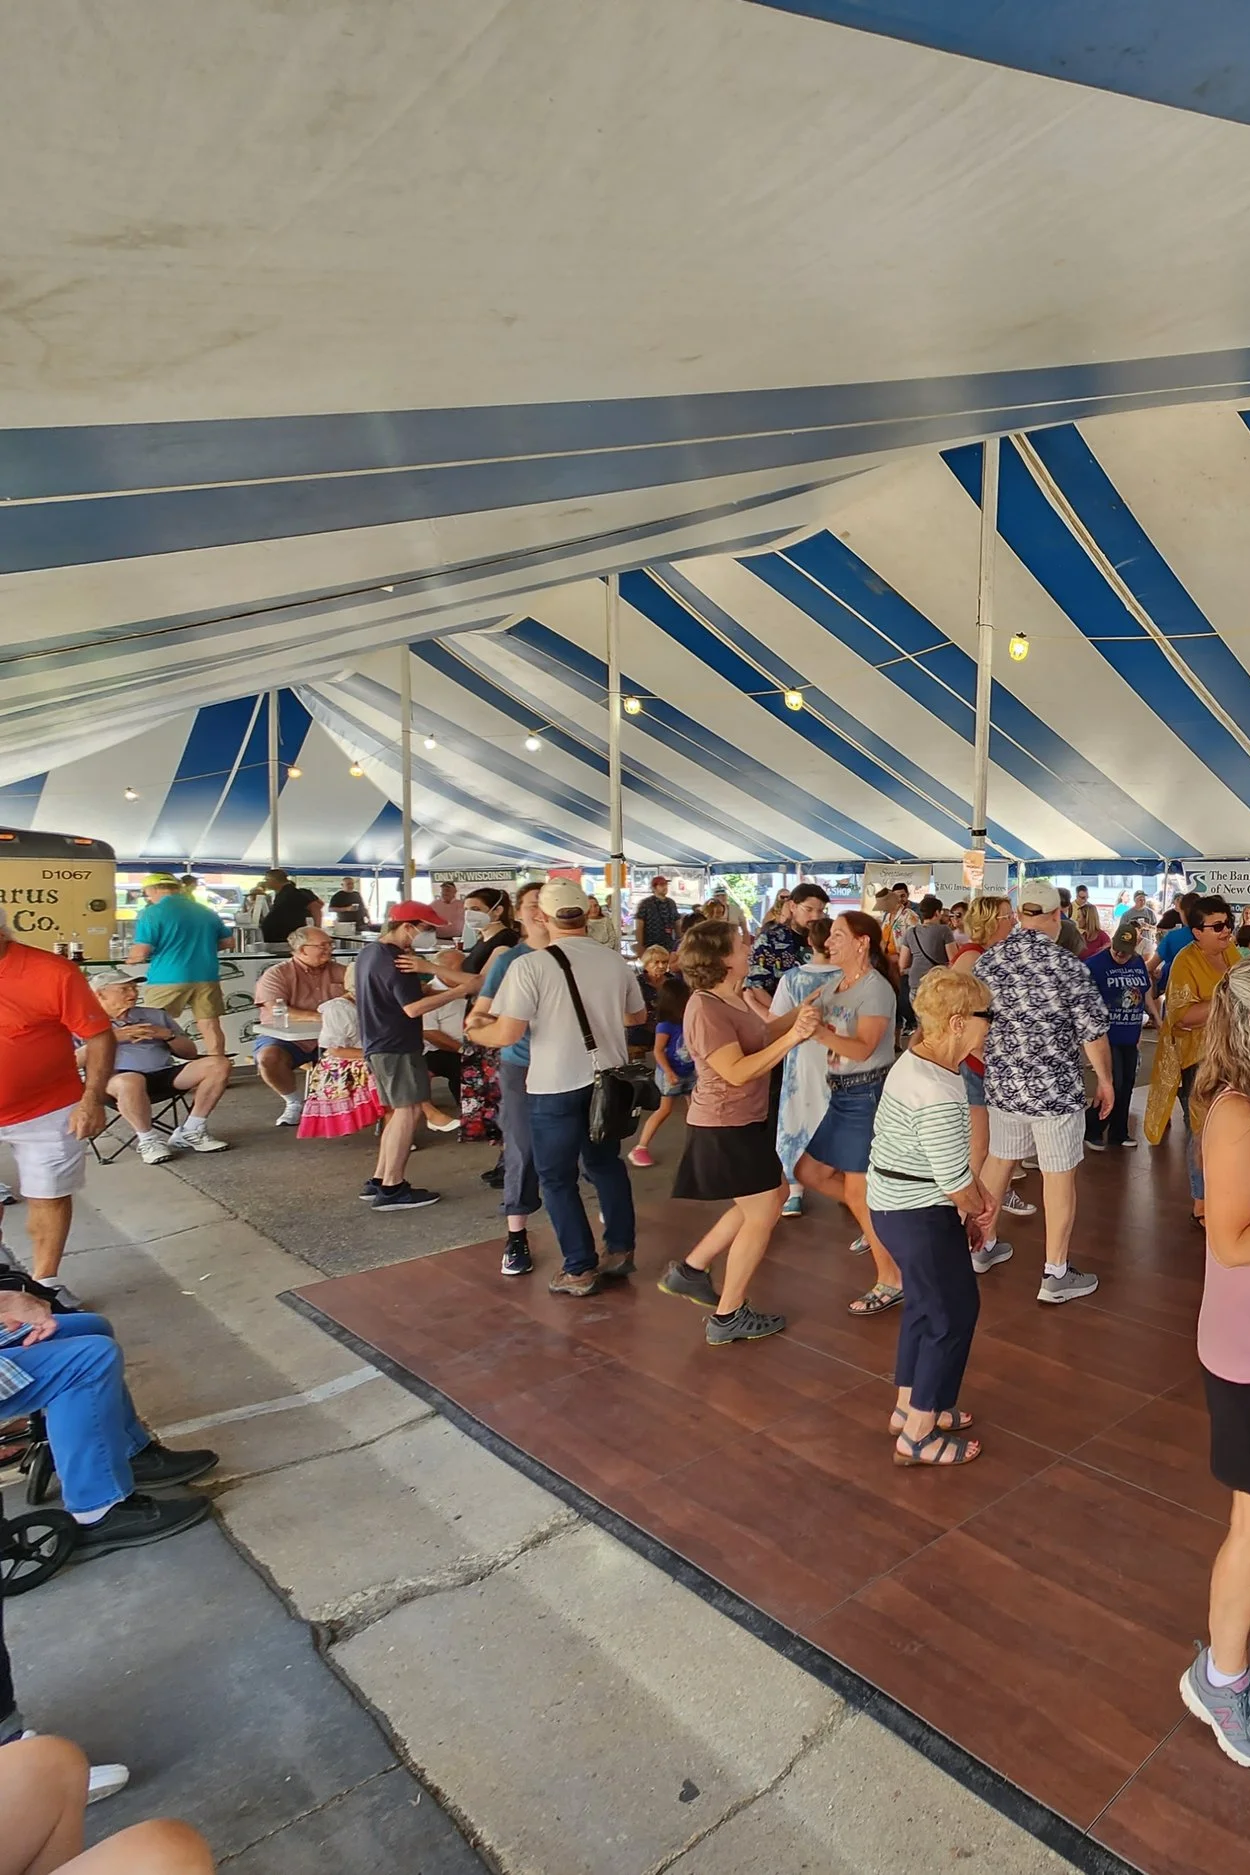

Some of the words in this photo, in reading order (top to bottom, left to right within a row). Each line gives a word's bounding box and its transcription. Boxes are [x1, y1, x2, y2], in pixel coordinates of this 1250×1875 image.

[42, 870, 92, 880] D1067
[434, 873, 454, 882] ONLY
[1208, 870, 1228, 881] The
[1210, 884, 1222, 894] of
[1223, 884, 1246, 895] New
[13, 909, 60, 933] Co.
